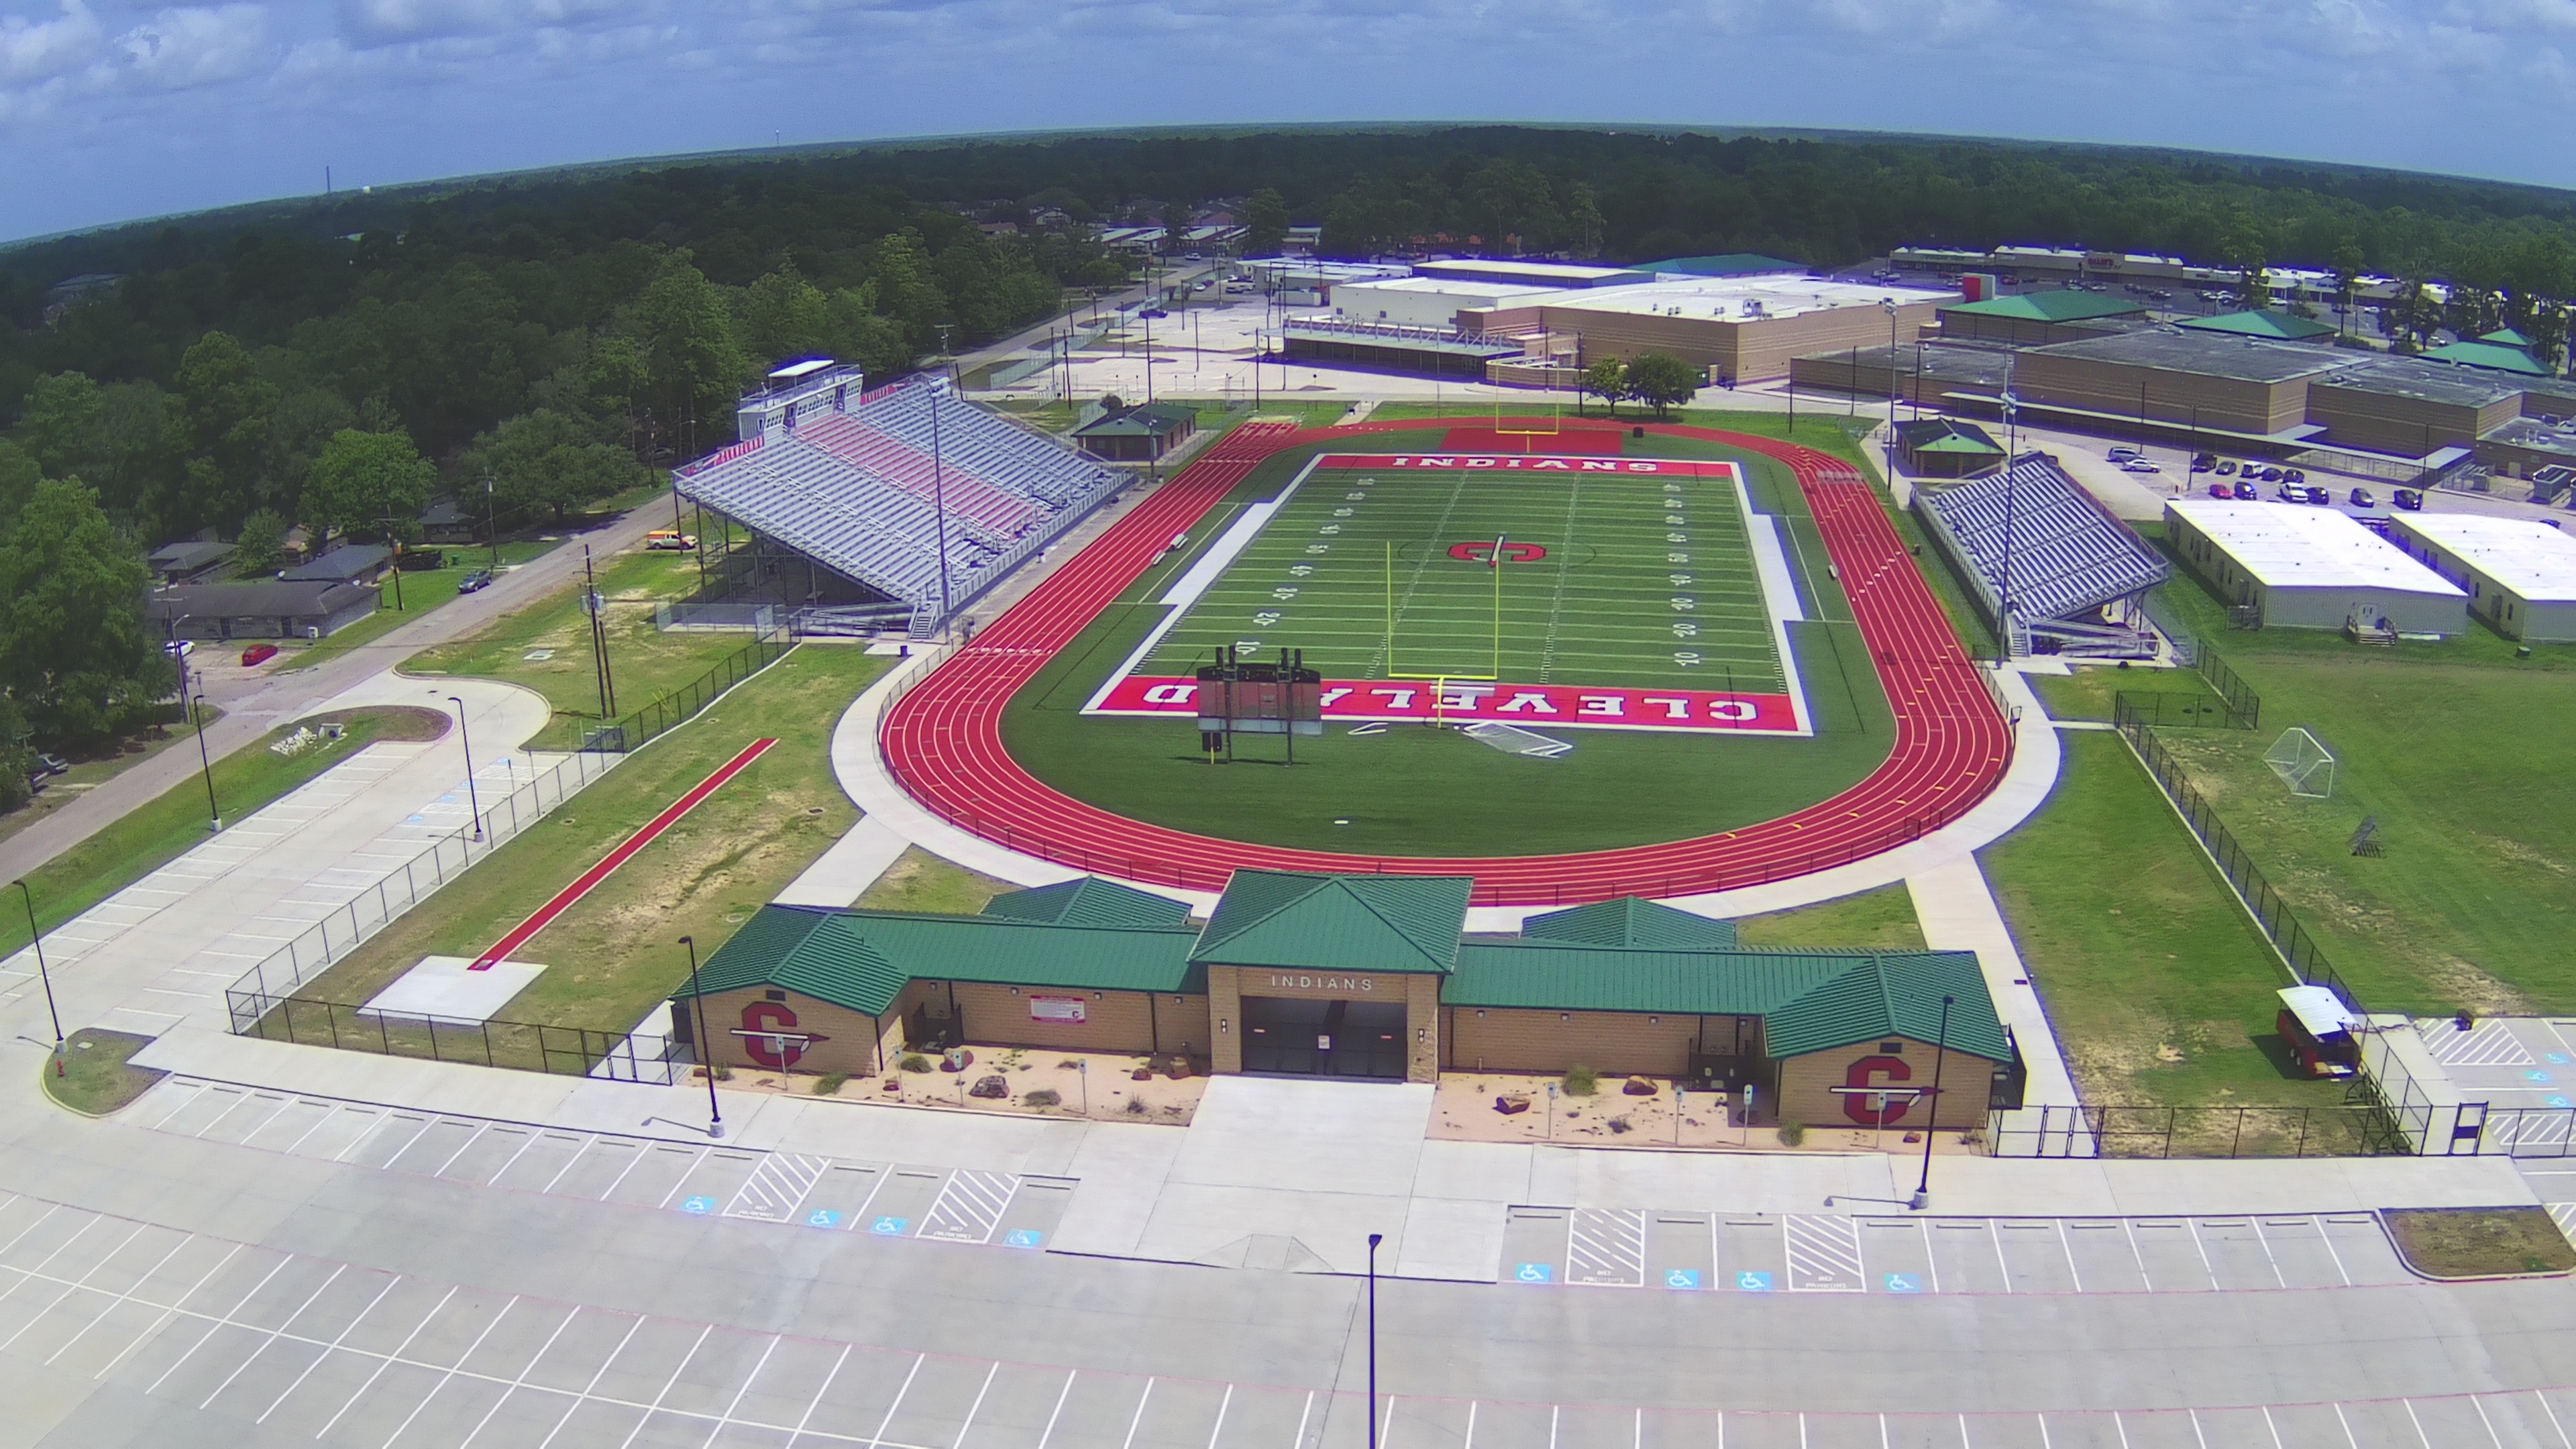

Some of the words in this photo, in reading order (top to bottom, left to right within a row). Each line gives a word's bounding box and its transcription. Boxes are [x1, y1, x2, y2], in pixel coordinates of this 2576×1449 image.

[1393, 458, 1657, 471] INDIANS
[1253, 612, 1280, 624] 20
[1672, 624, 1696, 636] 20
[1235, 641, 1260, 653] 10
[1674, 652, 1699, 665] 10
[1272, 975, 1372, 991] INDIANS
[742, 1002, 801, 1067] C
[1844, 1056, 1911, 1125] C
